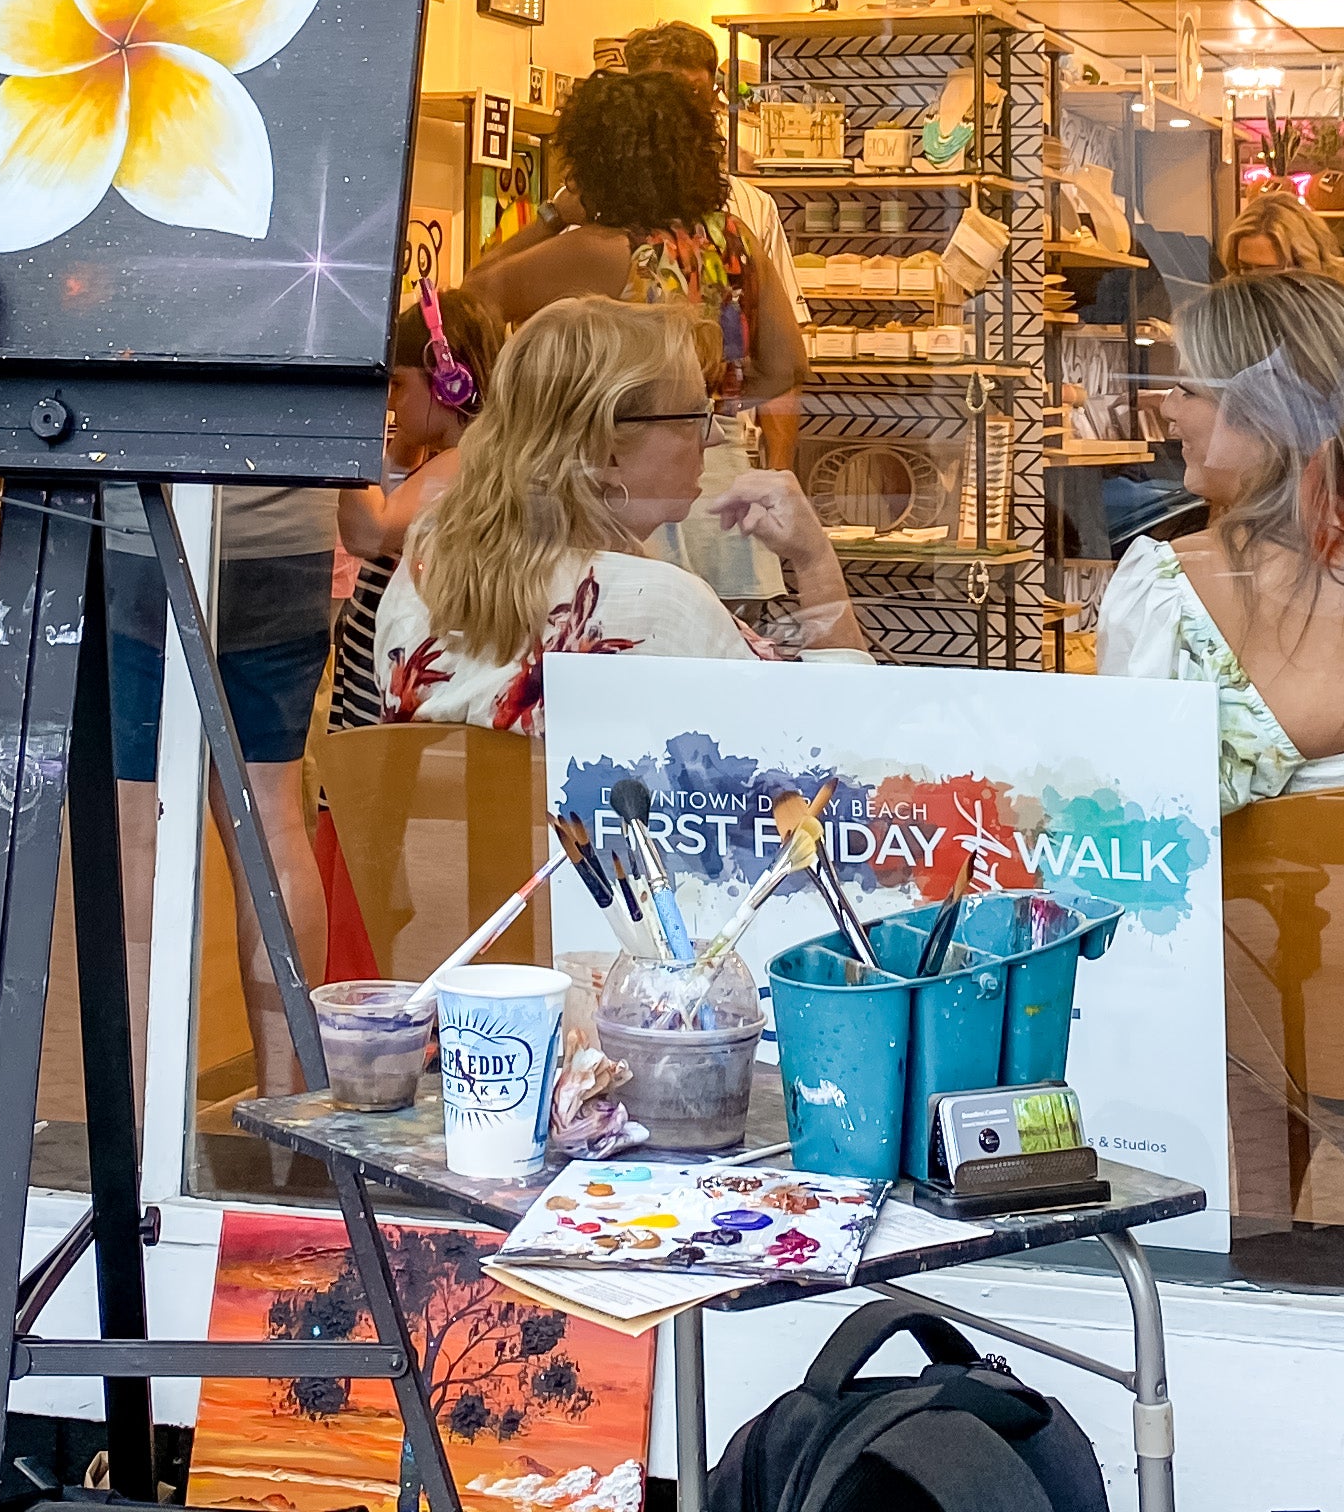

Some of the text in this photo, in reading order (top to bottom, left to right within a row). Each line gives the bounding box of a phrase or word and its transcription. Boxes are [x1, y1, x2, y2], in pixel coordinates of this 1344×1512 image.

[601, 787, 748, 812] DNTOWN
[851, 799, 928, 822] BEACH
[595, 808, 740, 857] FIRST
[754, 816, 946, 868] FIDAY
[1013, 831, 1182, 885] WALK
[467, 1054, 517, 1076] EDDY
[445, 1078, 510, 1096] ODKA
[1098, 1136, 1109, 1148] &
[1113, 1137, 1167, 1153] Studios
